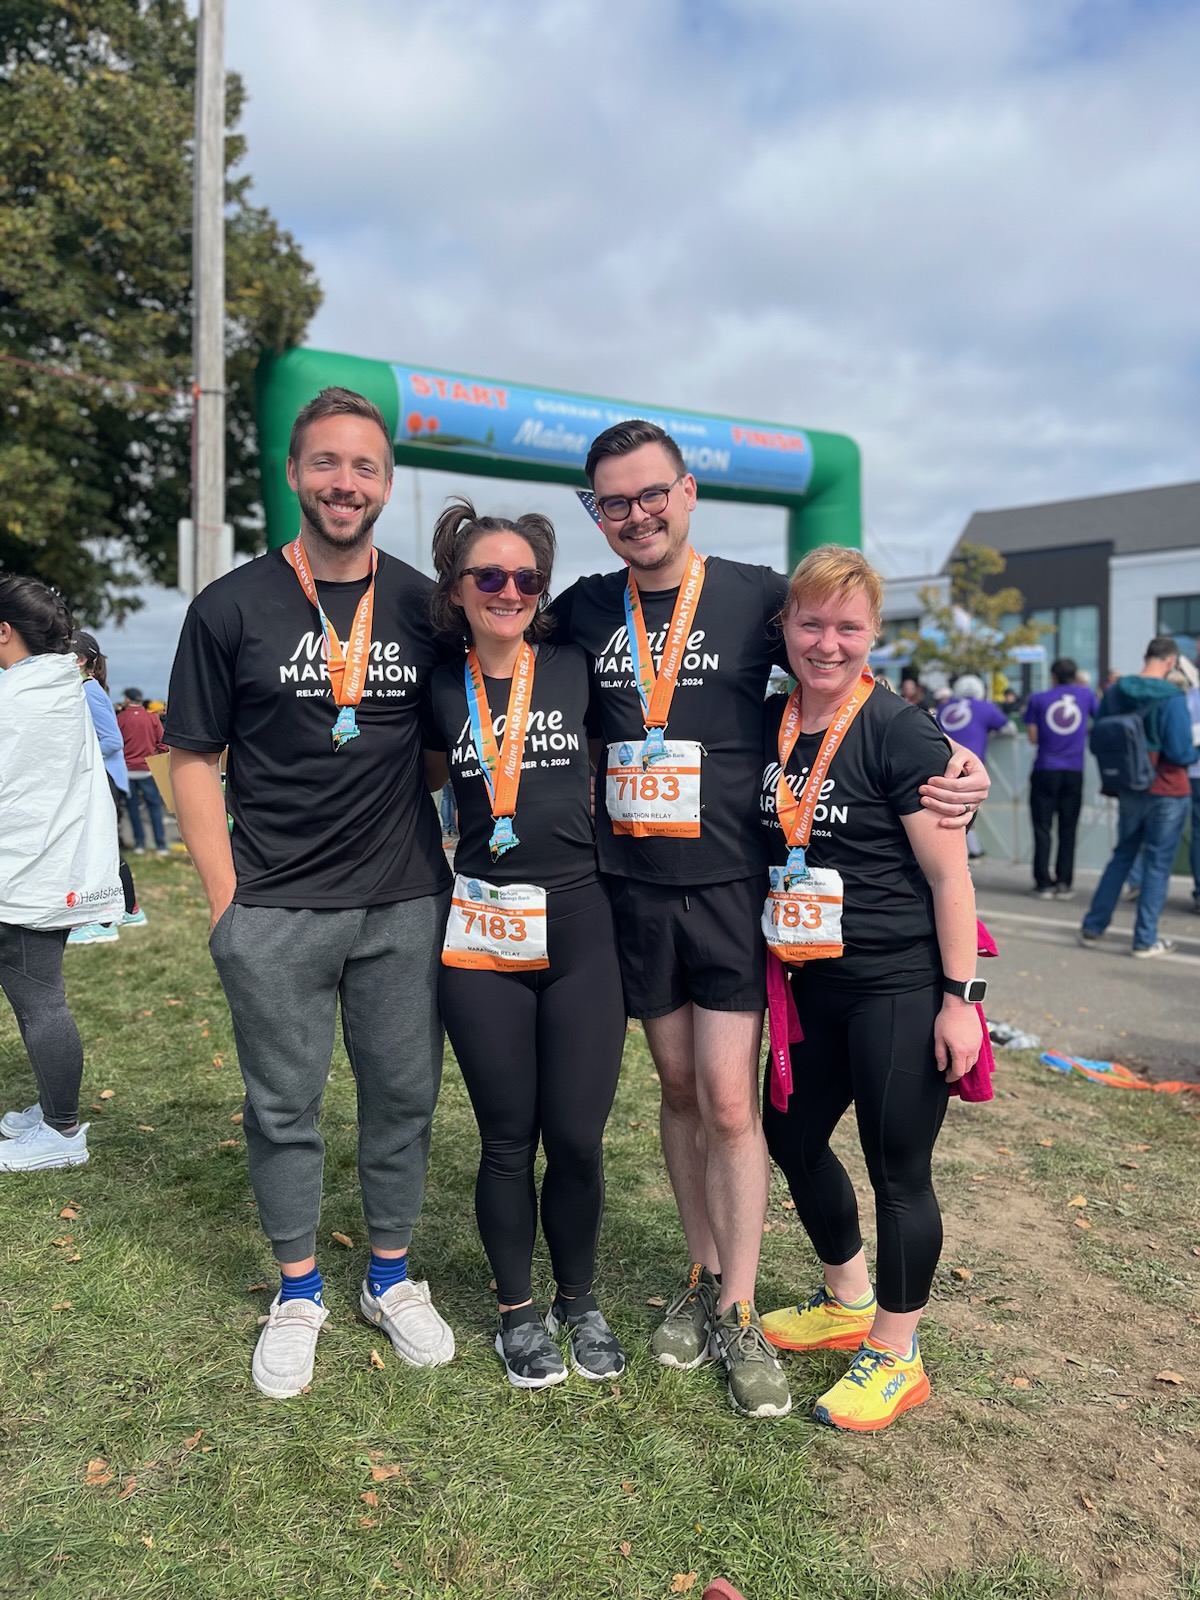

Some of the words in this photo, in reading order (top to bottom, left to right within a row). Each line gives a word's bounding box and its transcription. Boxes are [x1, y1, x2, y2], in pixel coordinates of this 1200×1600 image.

[410, 374, 509, 409] START
[512, 417, 588, 454] Maine
[289, 631, 401, 662] Mne
[352, 597, 370, 664] MARATHON
[601, 622, 706, 656] Maie
[663, 646, 680, 683] Maine
[672, 579, 698, 645] MARATHON
[280, 664, 417, 683] MARHON
[520, 647, 531, 677] RELAY
[594, 653, 720, 674] MARTON
[296, 689, 325, 698] RELAY
[346, 666, 362, 702] Maine
[376, 690, 385, 698] 6,
[386, 689, 406, 697] 2024
[682, 678, 704, 686] 2024
[510, 677, 527, 741] MARATHON
[452, 733, 579, 765] MAHON
[504, 743, 519, 780] Maine
[550, 758, 571, 767] 2024
[762, 762, 836, 800] Maie
[795, 806, 811, 844] Maine
[806, 734, 838, 803] MARATHON
[834, 697, 859, 733] RELAY
[615, 775, 681, 801] 7183
[812, 828, 833, 838] 2024
[461, 910, 527, 942] 7183
[467, 946, 499, 956] MARATHON
[881, 1371, 907, 1404] HOKA
